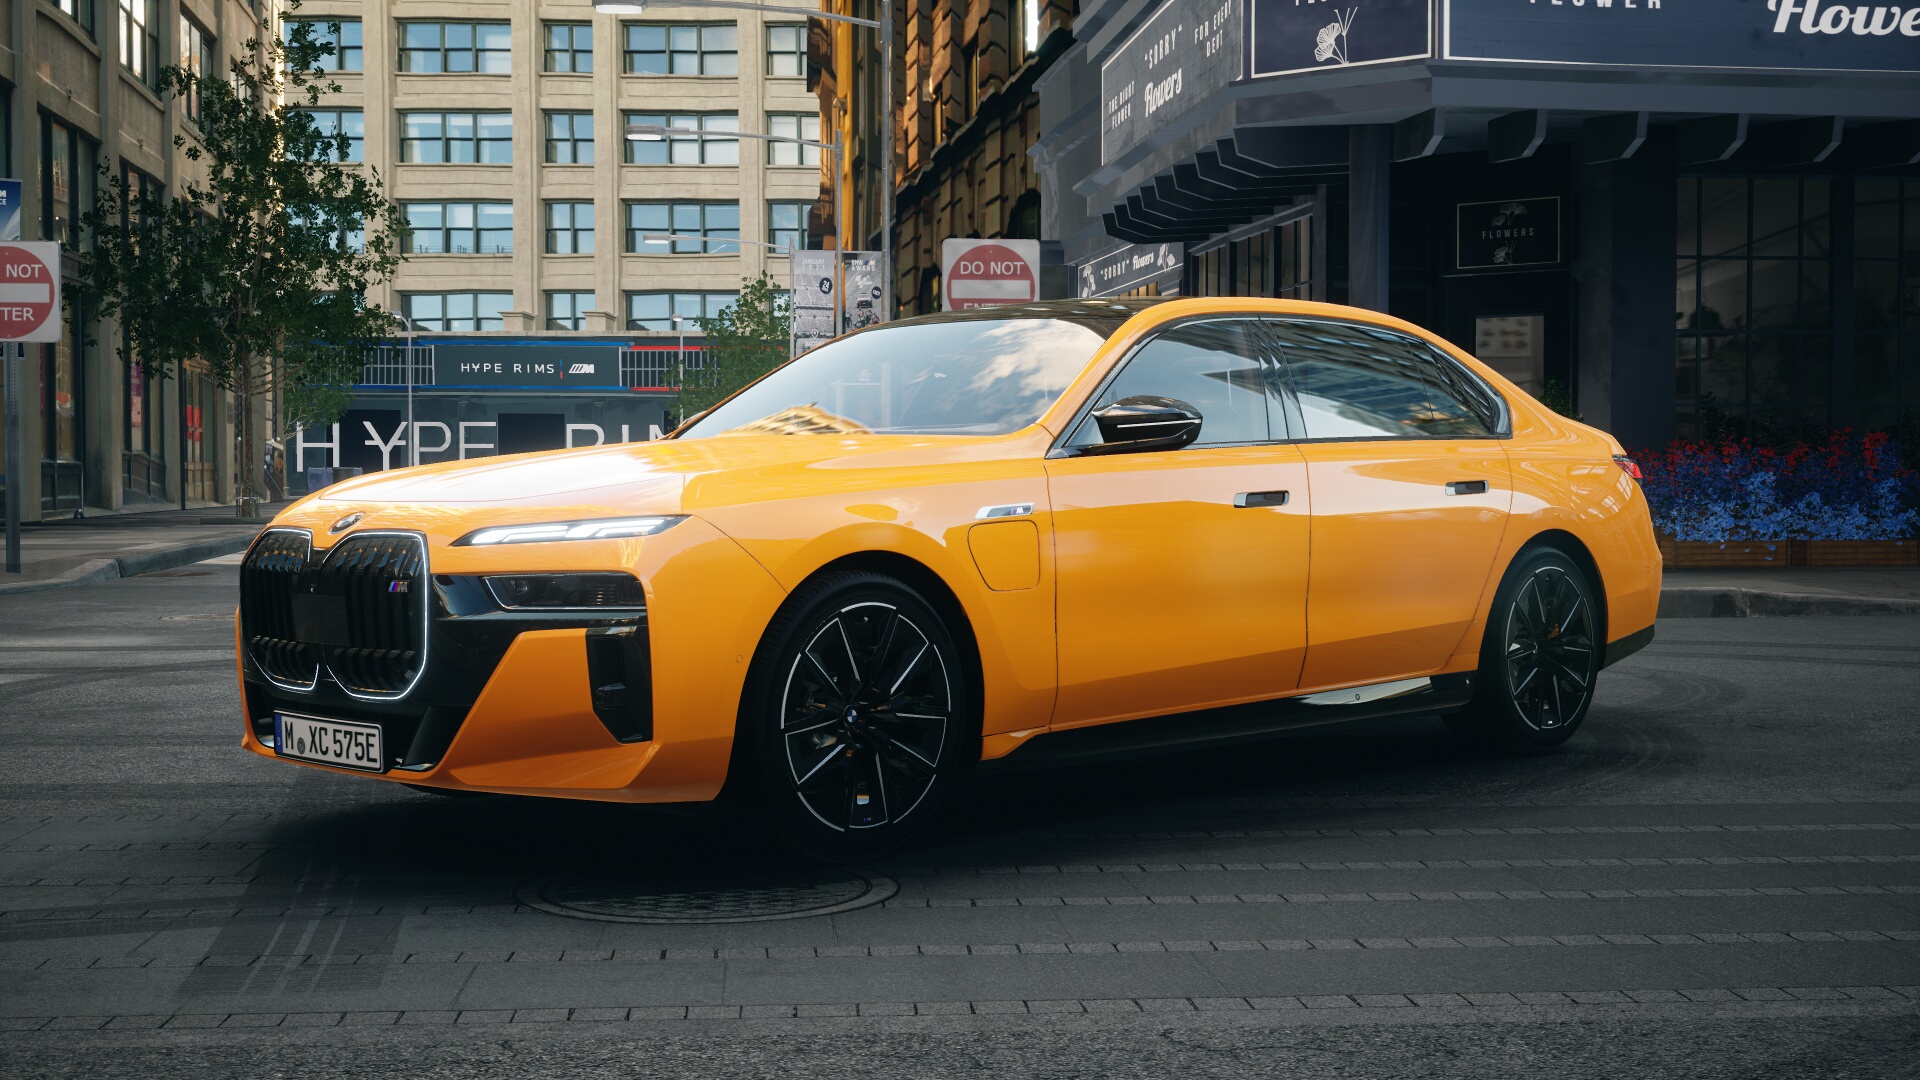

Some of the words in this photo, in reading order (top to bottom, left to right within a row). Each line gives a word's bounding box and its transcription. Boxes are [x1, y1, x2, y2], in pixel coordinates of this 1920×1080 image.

[1194, 21, 1209, 44] FOR
[1482, 227, 1534, 240] FLOWERS
[6, 263, 43, 278] NOT
[960, 261, 984, 275] DO
[990, 261, 1025, 275] NOT
[460, 362, 503, 373] HYPE
[513, 363, 555, 374] RIMS
[296, 420, 497, 473] HYPE
[284, 720, 294, 750] M
[308, 725, 329, 756] XC
[333, 729, 378, 763] 575E
